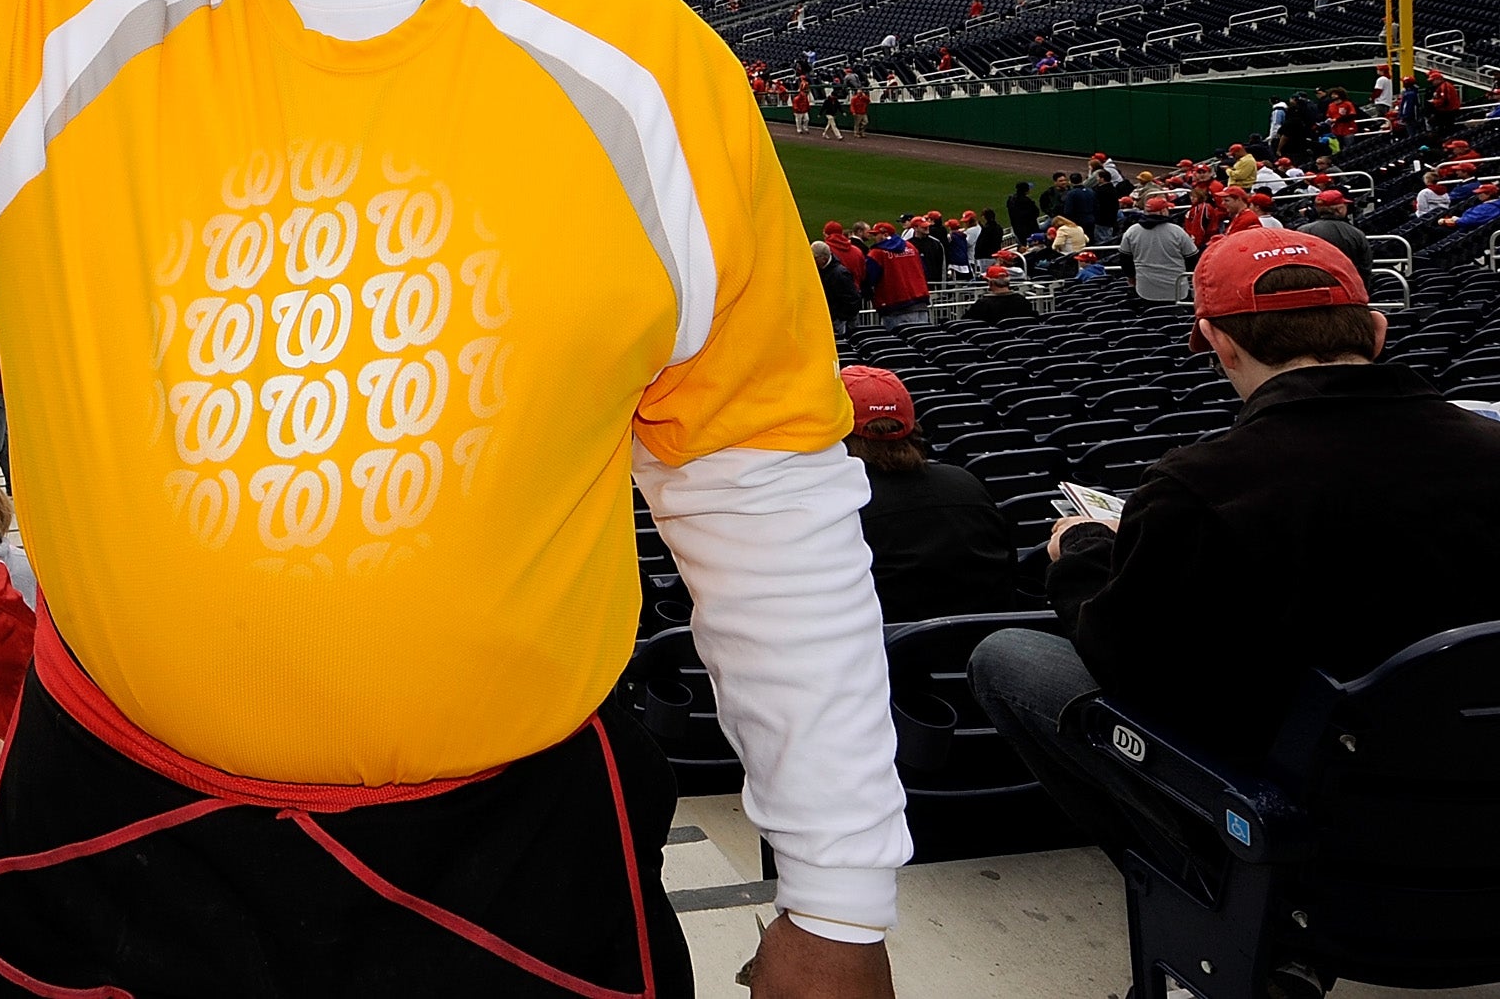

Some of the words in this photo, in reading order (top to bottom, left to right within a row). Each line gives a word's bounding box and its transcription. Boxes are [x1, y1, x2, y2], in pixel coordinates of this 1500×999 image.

[202, 211, 274, 291] W
[280, 201, 358, 285] W
[366, 181, 453, 266] W
[184, 293, 263, 376] W
[272, 283, 352, 369] W
[361, 262, 452, 352] W
[169, 379, 253, 464] W
[260, 369, 349, 459] W
[357, 350, 449, 443] W
[248, 459, 342, 551] W
[351, 440, 443, 536] W
[1116, 728, 1142, 756] DD
